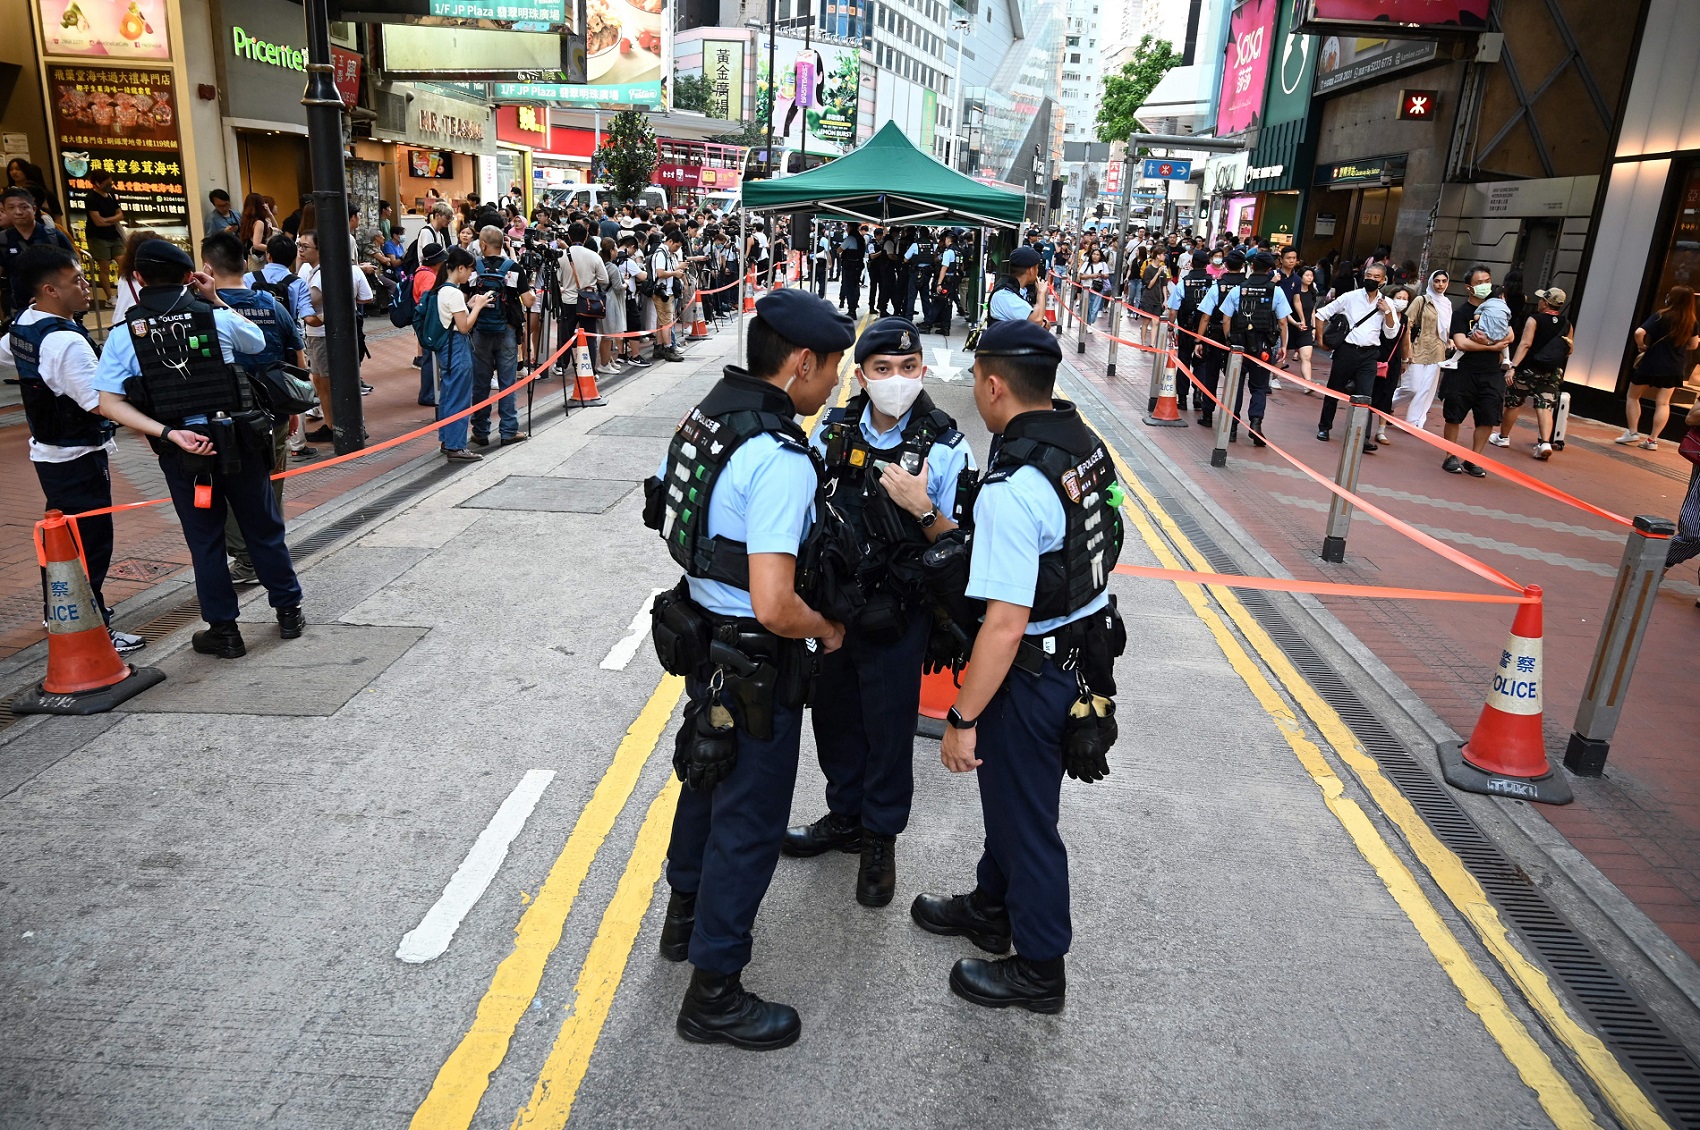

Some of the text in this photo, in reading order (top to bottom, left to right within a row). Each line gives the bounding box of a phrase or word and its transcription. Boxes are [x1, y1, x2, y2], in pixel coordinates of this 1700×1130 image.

[435, 3, 560, 21] 1/F JP Plaza 翡翠明珠廣場
[233, 26, 303, 72] Pricerite
[54, 68, 171, 86] 飛藥堂海味過大禮專門店
[715, 48, 730, 120] 黃金廣場
[500, 84, 620, 101] 1/F JP Plaza 翡翠明珠廣場
[418, 109, 441, 133] MR.
[90, 158, 181, 176] 飛藥堂參茸海味
[697, 412, 715, 430] POLICE
[1081, 451, 1099, 473] POLICE
[51, 581, 69, 597] 察
[1499, 649, 1536, 673] 警察
